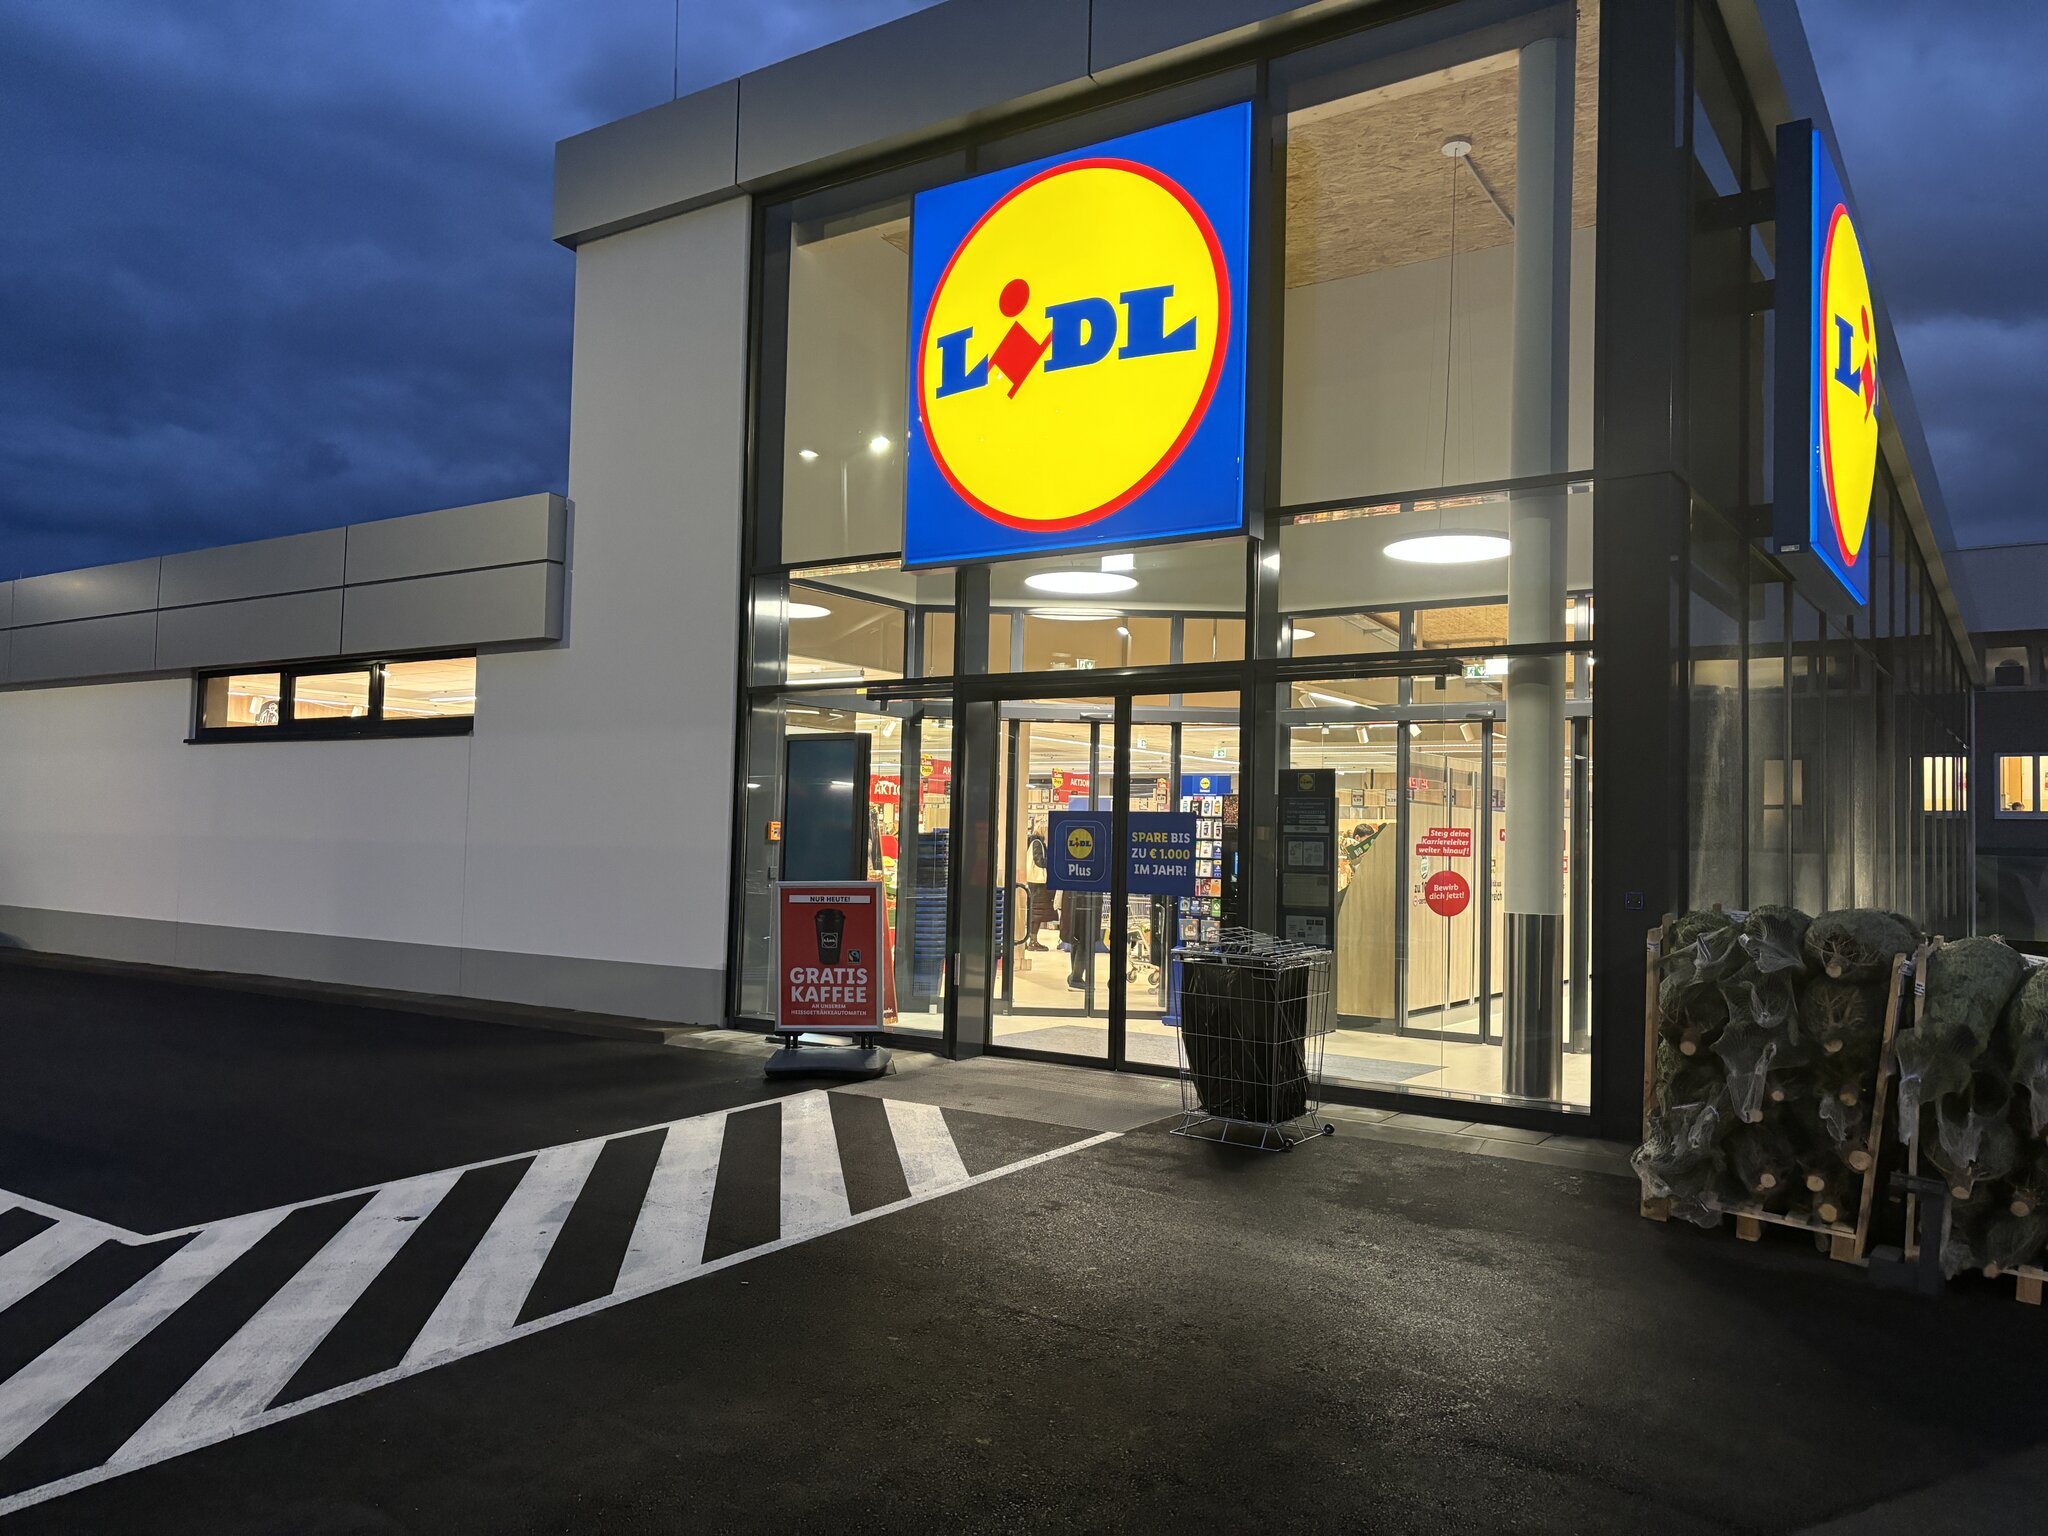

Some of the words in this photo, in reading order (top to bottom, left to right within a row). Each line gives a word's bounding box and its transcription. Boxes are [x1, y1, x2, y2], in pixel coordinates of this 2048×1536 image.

[1132, 832, 1168, 843] SPARE
[1171, 833, 1191, 843] BIS
[1430, 829, 1448, 839] Steig
[1450, 830, 1469, 838] deine
[1421, 838, 1469, 846] Karriereleiter
[1131, 848, 1147, 859] ZU
[1149, 849, 1157, 859] €
[1159, 849, 1190, 860] 1.000
[1418, 845, 1441, 854] weiter
[1443, 847, 1469, 856] hinauf!
[1068, 863, 1091, 876] Plus
[1134, 864, 1150, 875] IM
[1152, 865, 1187, 876] JAHR!
[1434, 884, 1459, 892] Bewirb
[1429, 891, 1445, 900] dich
[1446, 891, 1465, 900] jetzt!
[790, 967, 868, 985] GRATIS
[791, 985, 867, 1003] KAFFEE
